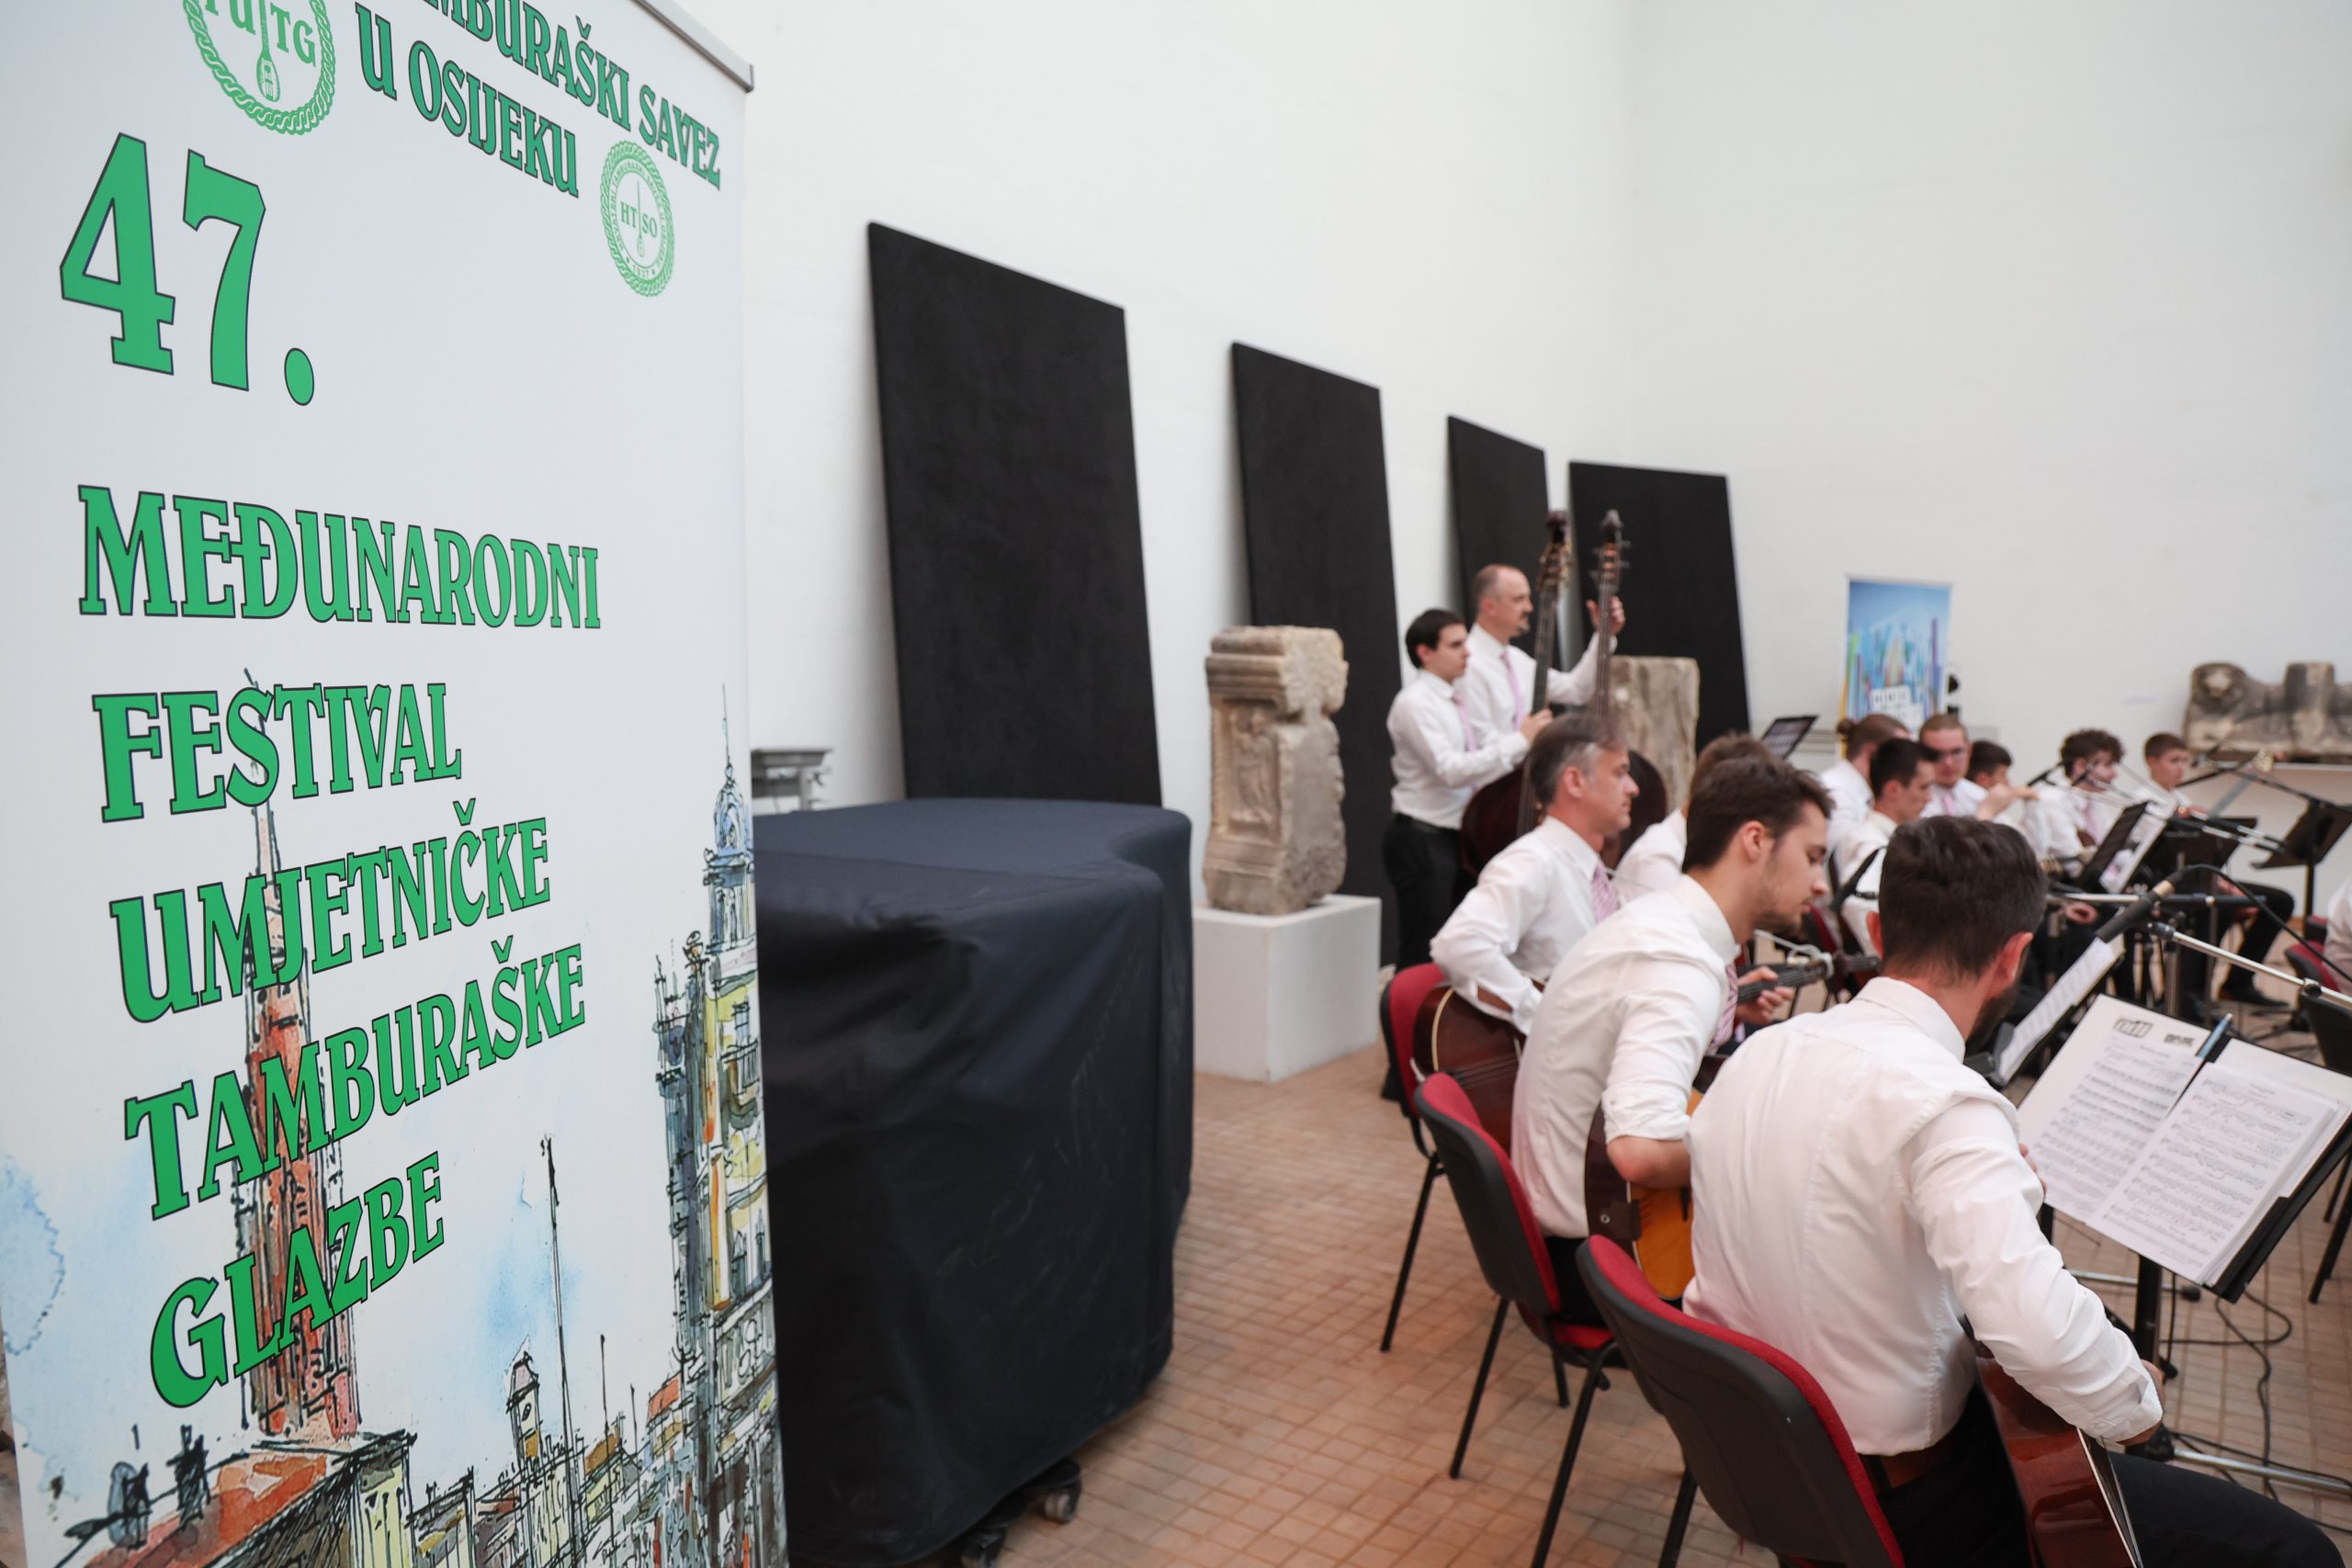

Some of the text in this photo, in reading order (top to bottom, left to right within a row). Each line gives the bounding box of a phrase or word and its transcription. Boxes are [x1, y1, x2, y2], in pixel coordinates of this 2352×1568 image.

[205, 0, 316, 67] U TG
[355, 1, 579, 198] U OSIJEKU
[620, 200, 658, 239] HT SO
[639, 84, 720, 190] SAVEZ
[60, 132, 315, 406] 47.
[78, 484, 601, 629] MEĐUNARODNI
[92, 682, 462, 823] FESTIVAL
[109, 798, 550, 1023] UMJETNIČKE
[124, 935, 585, 1221] TAMBURAŠKE
[150, 1151, 445, 1408] GLAZBE
